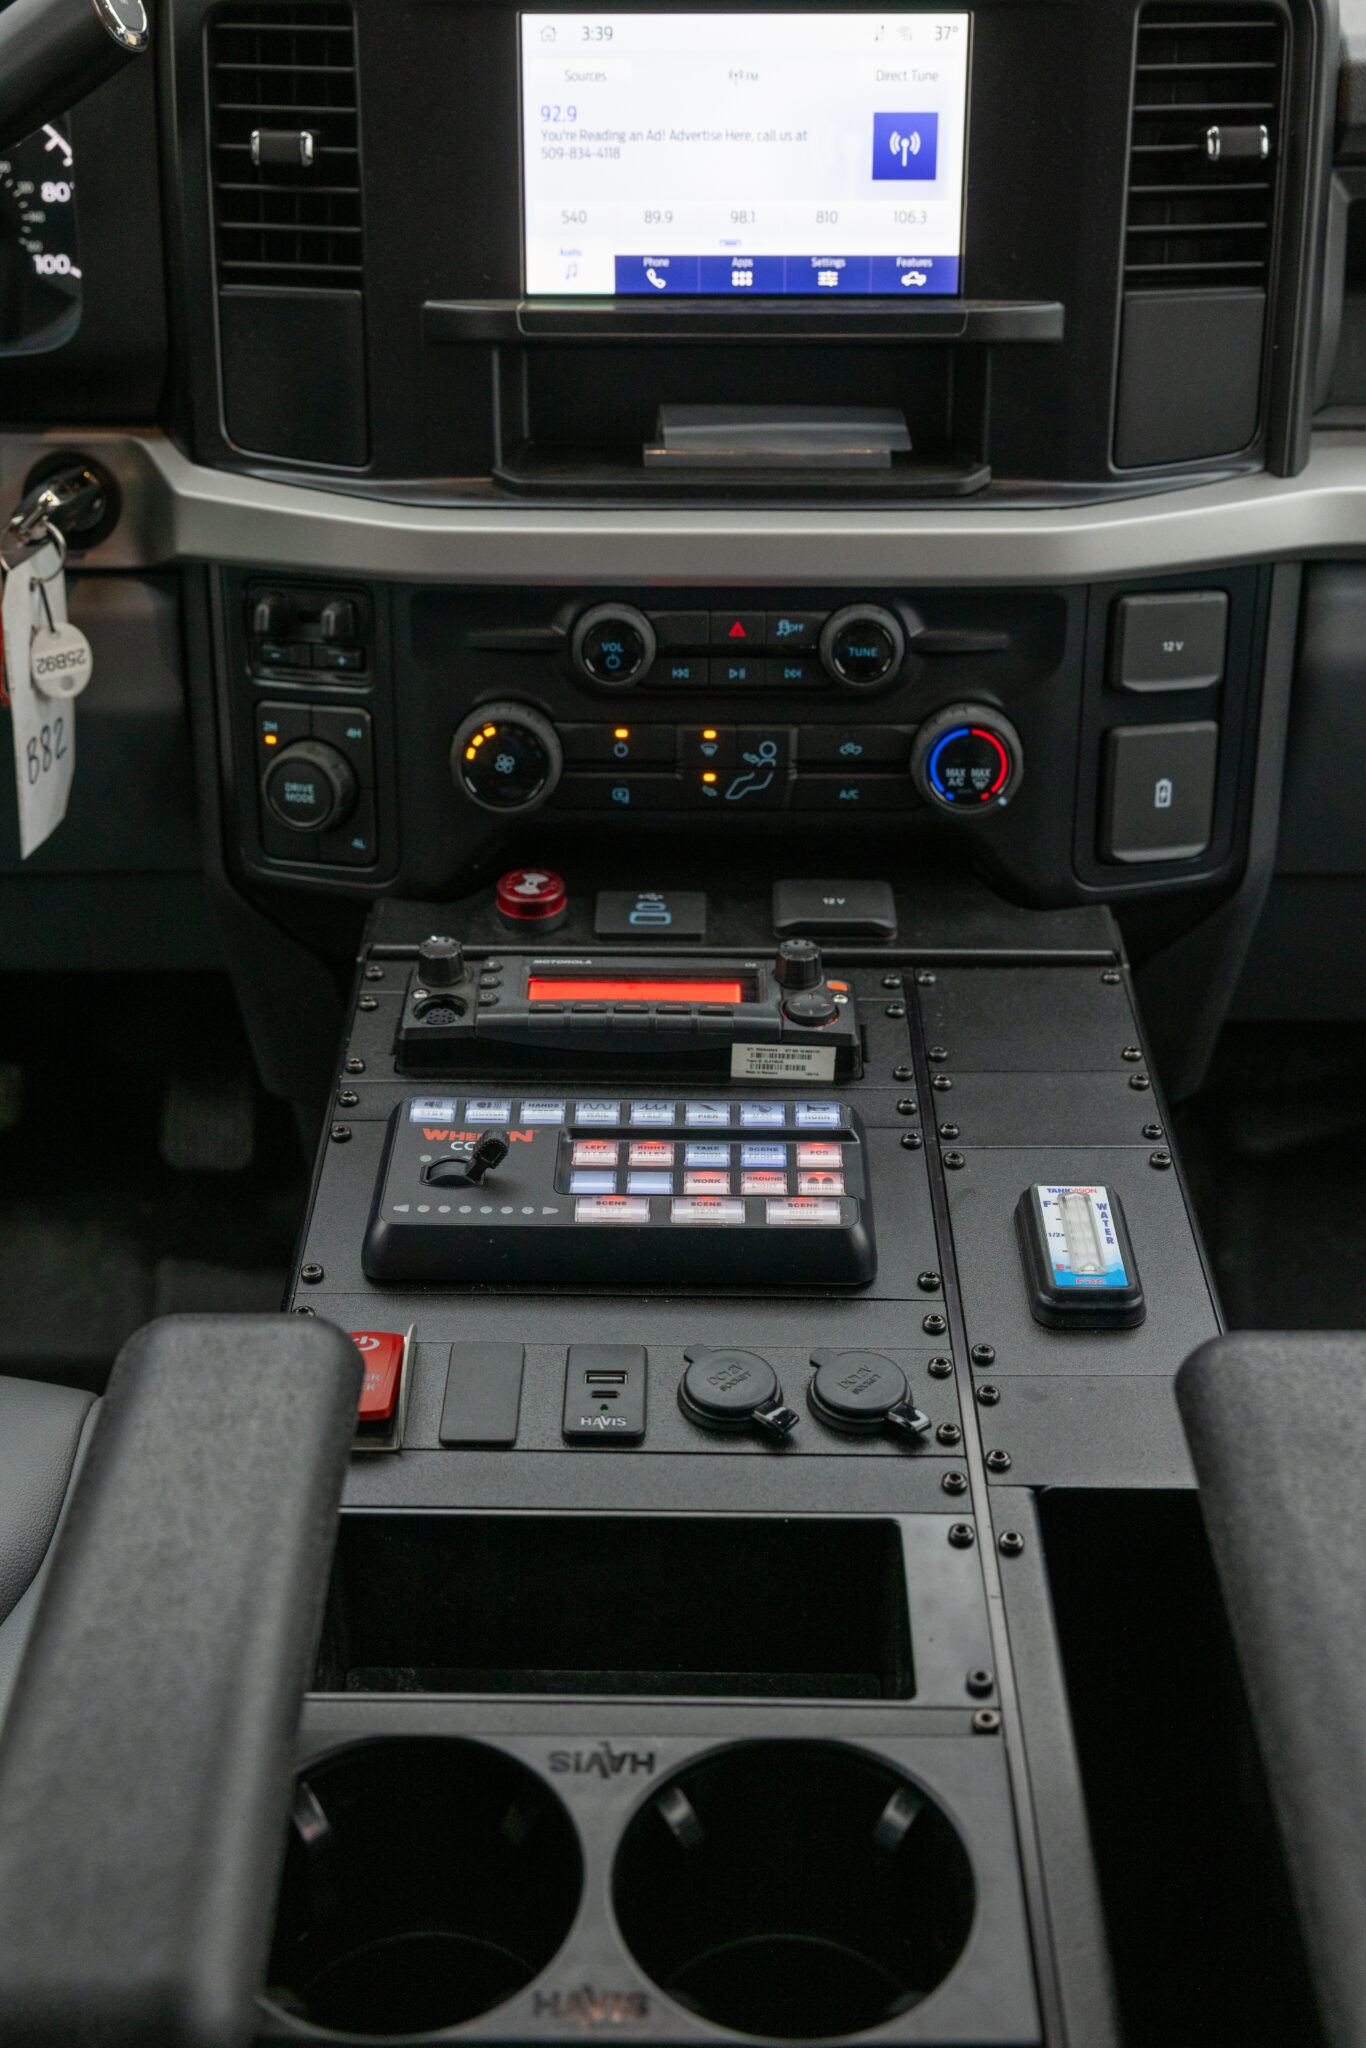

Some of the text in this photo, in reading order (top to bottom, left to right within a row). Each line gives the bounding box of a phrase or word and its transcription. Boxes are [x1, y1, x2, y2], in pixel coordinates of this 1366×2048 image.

[581, 25, 614, 42] 3:39
[564, 69, 607, 82] Sources
[875, 69, 939, 82] Direct Tune
[539, 104, 577, 123] 92.9
[540, 129, 577, 142] You're
[579, 129, 627, 144] Reading
[628, 132, 644, 142] an
[668, 129, 722, 142] Advertise
[756, 129, 777, 142] call
[779, 132, 793, 142] us
[795, 130, 808, 142] at
[540, 146, 621, 160] 509-834-4118
[40, 180, 72, 203] 80
[561, 209, 588, 224] 540
[643, 209, 674, 224] 89.9
[729, 209, 756, 224] 98.1
[815, 209, 839, 224] 810
[893, 209, 928, 224] 106.3
[32, 253, 72, 275] 100
[642, 257, 670, 268] Phone
[731, 257, 754, 269] Apps
[811, 257, 846, 269] Settings
[895, 257, 933, 268] Features
[601, 641, 624, 653] VOL
[848, 646, 878, 658] TUNE
[945, 767, 967, 778] MAX
[970, 767, 992, 778] MAX
[283, 781, 315, 793] DRIVE
[285, 792, 316, 804] MODE
[838, 789, 860, 800] A/C
[532, 958, 593, 966] MOTOROLA
[1096, 1202, 1115, 1245] WATER
[580, 1415, 627, 1430] HAVIS
[548, 1741, 656, 1779] HAVIS
